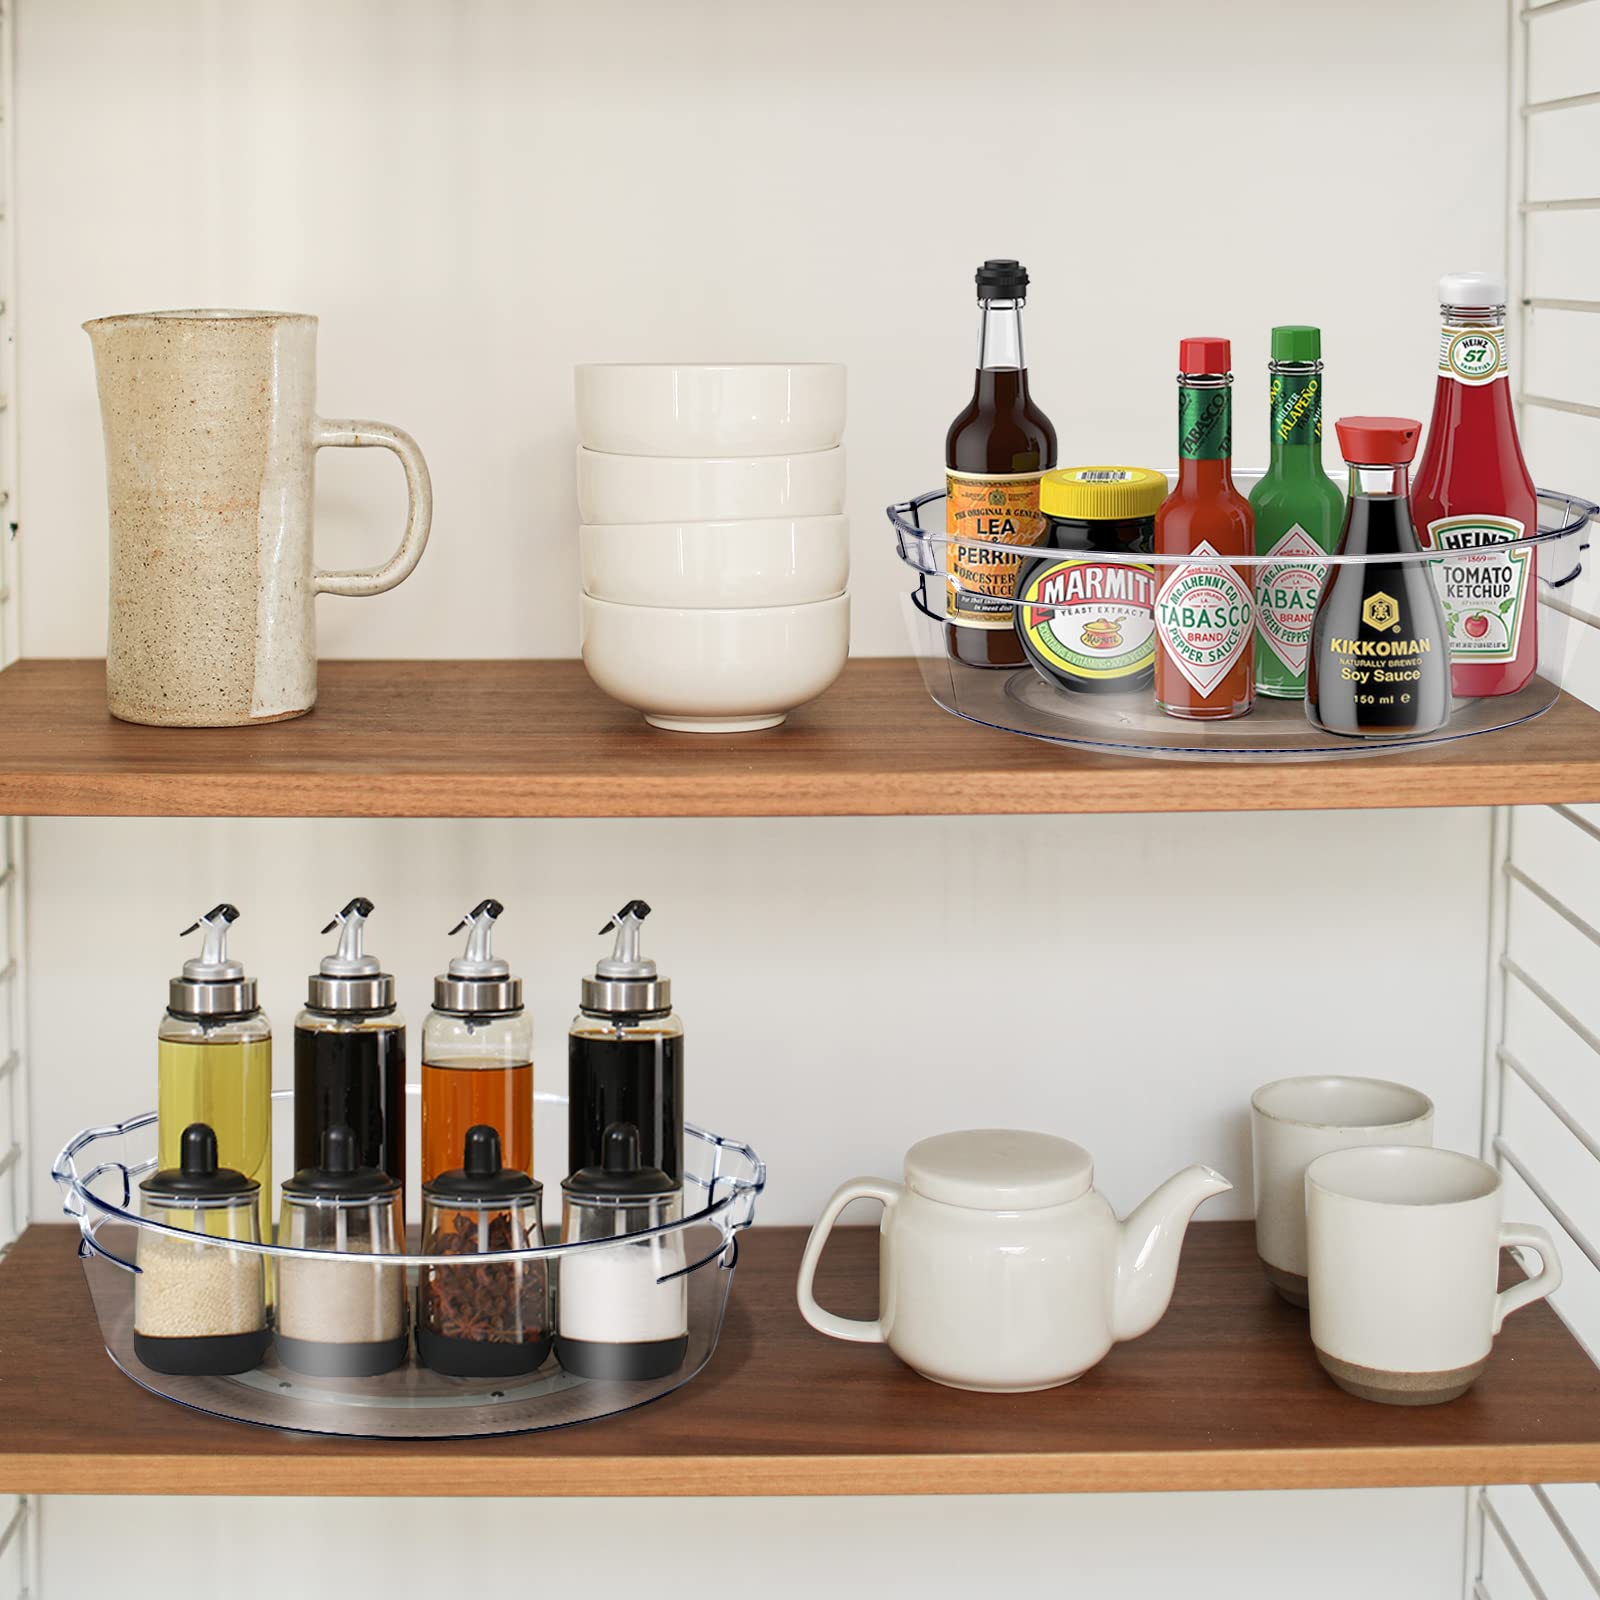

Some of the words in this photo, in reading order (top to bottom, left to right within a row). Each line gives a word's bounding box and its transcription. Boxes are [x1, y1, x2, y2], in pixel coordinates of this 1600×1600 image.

[1462, 338, 1489, 349] HEINZ
[1463, 349, 1487, 363] 57
[1460, 362, 1491, 371] VARIETIES
[1276, 392, 1301, 423] MILDER
[1277, 380, 1318, 441] JALAPEÑO
[1182, 392, 1226, 454] TABASCO
[967, 508, 1003, 517] ORIGINAL
[976, 518, 1016, 535] LEA
[957, 545, 1025, 565] PERRIN
[1443, 566, 1513, 584] TOMATO
[1447, 585, 1511, 599] KETCHUP
[1061, 607, 1093, 617] YEAST
[1097, 607, 1145, 617] EXTRACT
[1160, 603, 1251, 629] TABASCO
[1262, 609, 1282, 636] GREEN
[1169, 628, 1204, 663] PEPPER
[1209, 628, 1241, 663] SAUCE
[1187, 632, 1224, 643] BRAND
[1330, 638, 1431, 657] KIKKOMAN
[1339, 657, 1387, 668] NATURALLY
[1388, 658, 1423, 668] BREWED
[1341, 667, 1370, 684] Soy
[1373, 669, 1421, 682] Sauce
[1353, 694, 1375, 704] 150
[1379, 695, 1395, 704] ml
